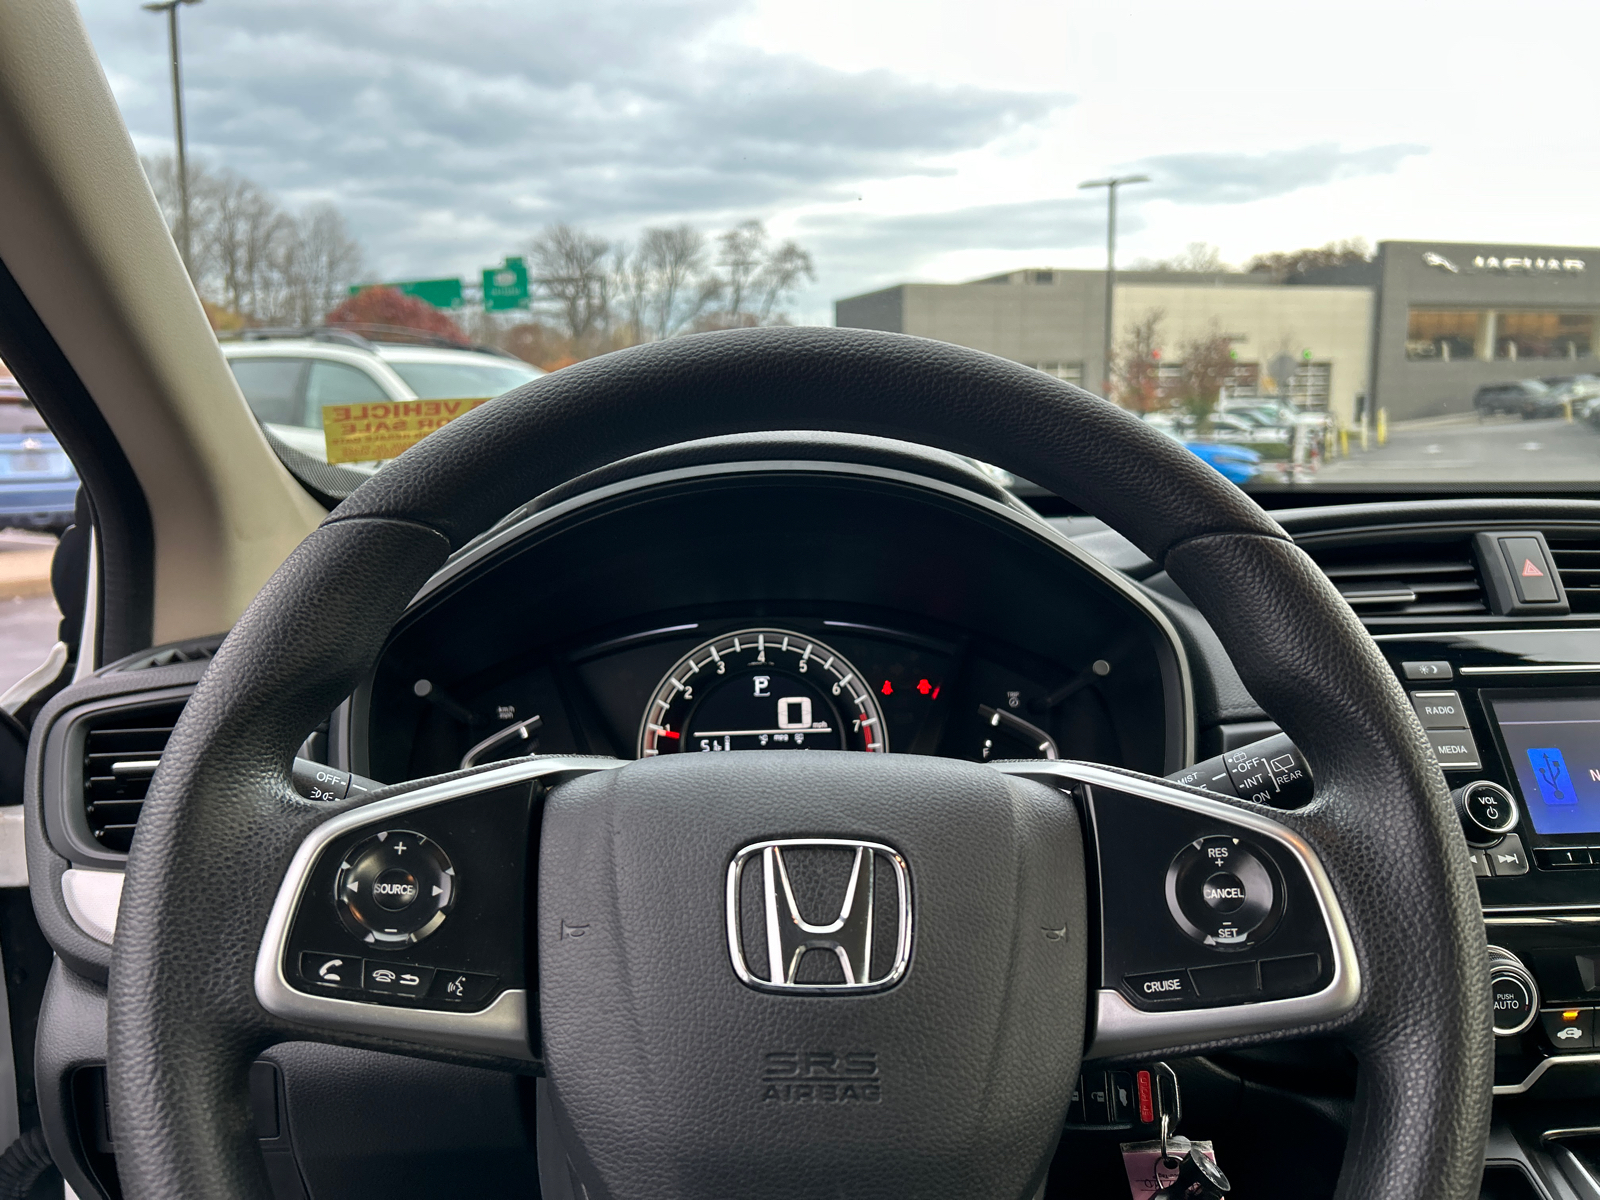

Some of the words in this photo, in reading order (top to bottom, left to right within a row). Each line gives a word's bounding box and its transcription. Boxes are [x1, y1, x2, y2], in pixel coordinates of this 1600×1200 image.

[757, 650, 766, 662] 4
[716, 661, 726, 675] 3
[799, 659, 808, 673] 5
[683, 685, 693, 699] 2
[832, 682, 841, 696] 6
[777, 697, 812, 729] 0
[1425, 706, 1455, 715] RADIO
[852, 719, 860, 733] 7
[1438, 745, 1468, 754] MEDIA
[1237, 756, 1260, 773] OFF
[316, 771, 341, 786] OFF
[1243, 773, 1263, 789] INT
[1276, 769, 1303, 786] REAR
[1252, 790, 1271, 805] ON
[1478, 796, 1498, 805] VOL
[1207, 847, 1229, 858] RES
[373, 883, 414, 895] SOURCE
[1203, 888, 1245, 899] CANCEL
[1218, 928, 1239, 939] SET
[1143, 978, 1182, 993] CRUISE
[1493, 1001, 1519, 1010] AUTO
[765, 1052, 879, 1076] SRS
[763, 1084, 882, 1103] AIRBAG
